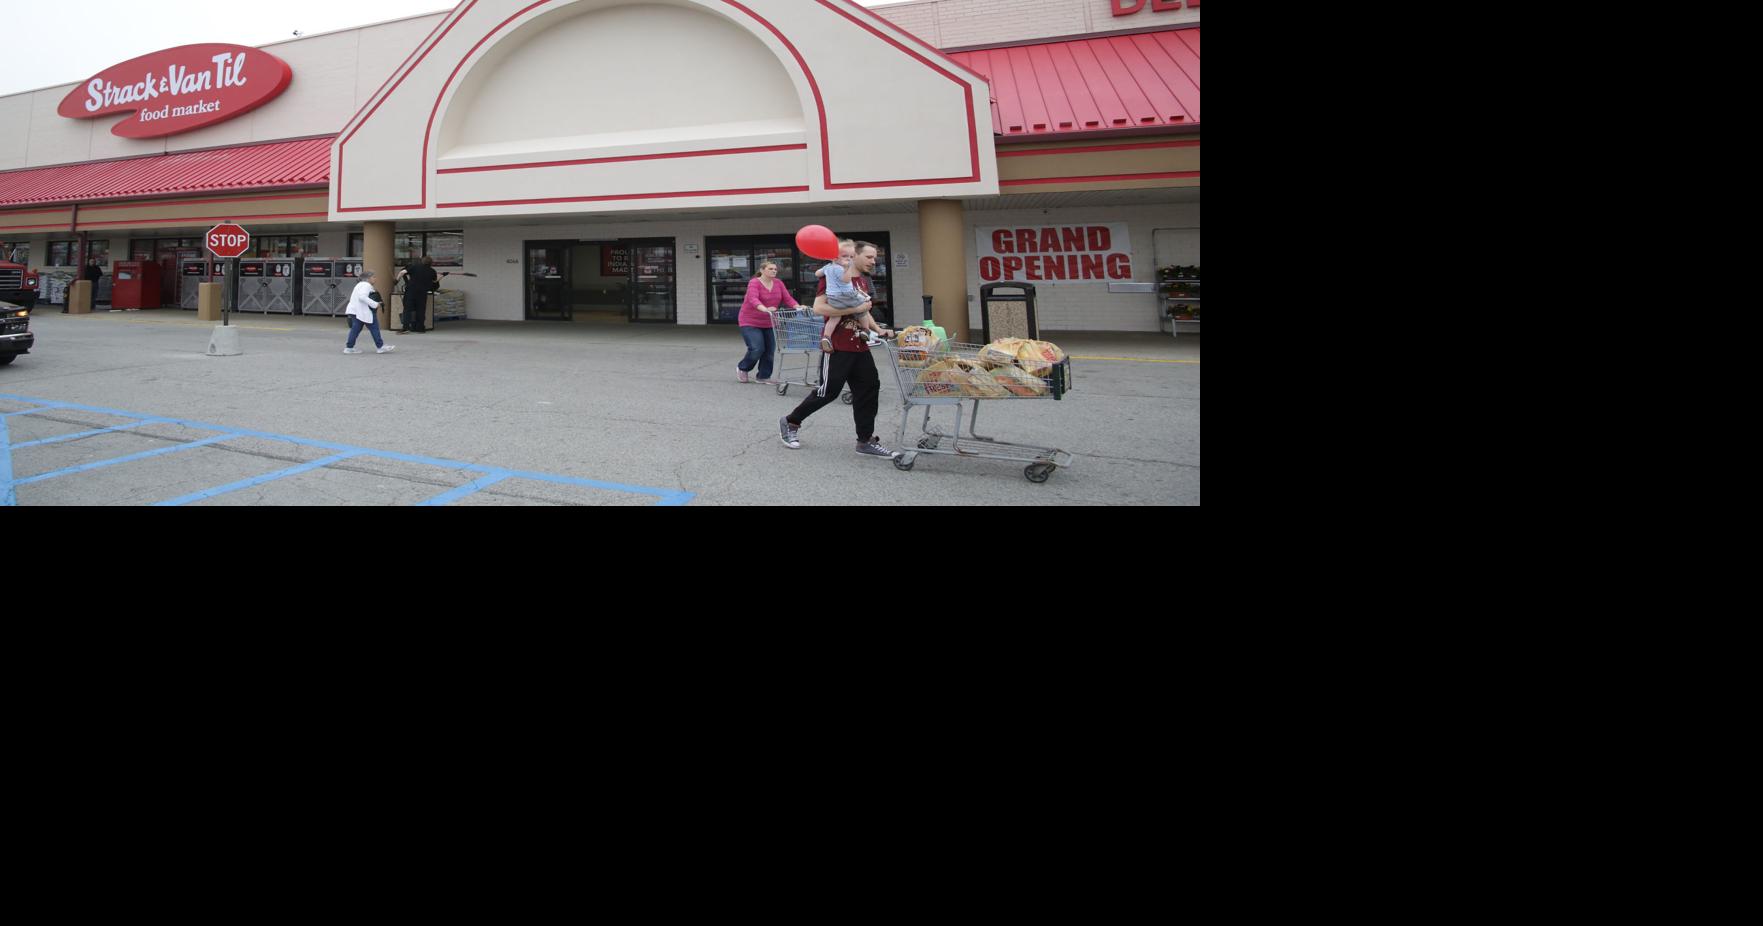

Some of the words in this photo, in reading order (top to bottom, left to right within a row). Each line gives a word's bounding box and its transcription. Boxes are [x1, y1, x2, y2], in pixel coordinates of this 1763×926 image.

[85, 72, 159, 112] Strack
[168, 64, 212, 96] Van
[212, 52, 247, 89] Til
[139, 105, 169, 122] food
[171, 100, 220, 118] market
[210, 234, 247, 247] STOP
[991, 226, 1112, 254] GRAND
[979, 253, 1132, 281] OPENING
